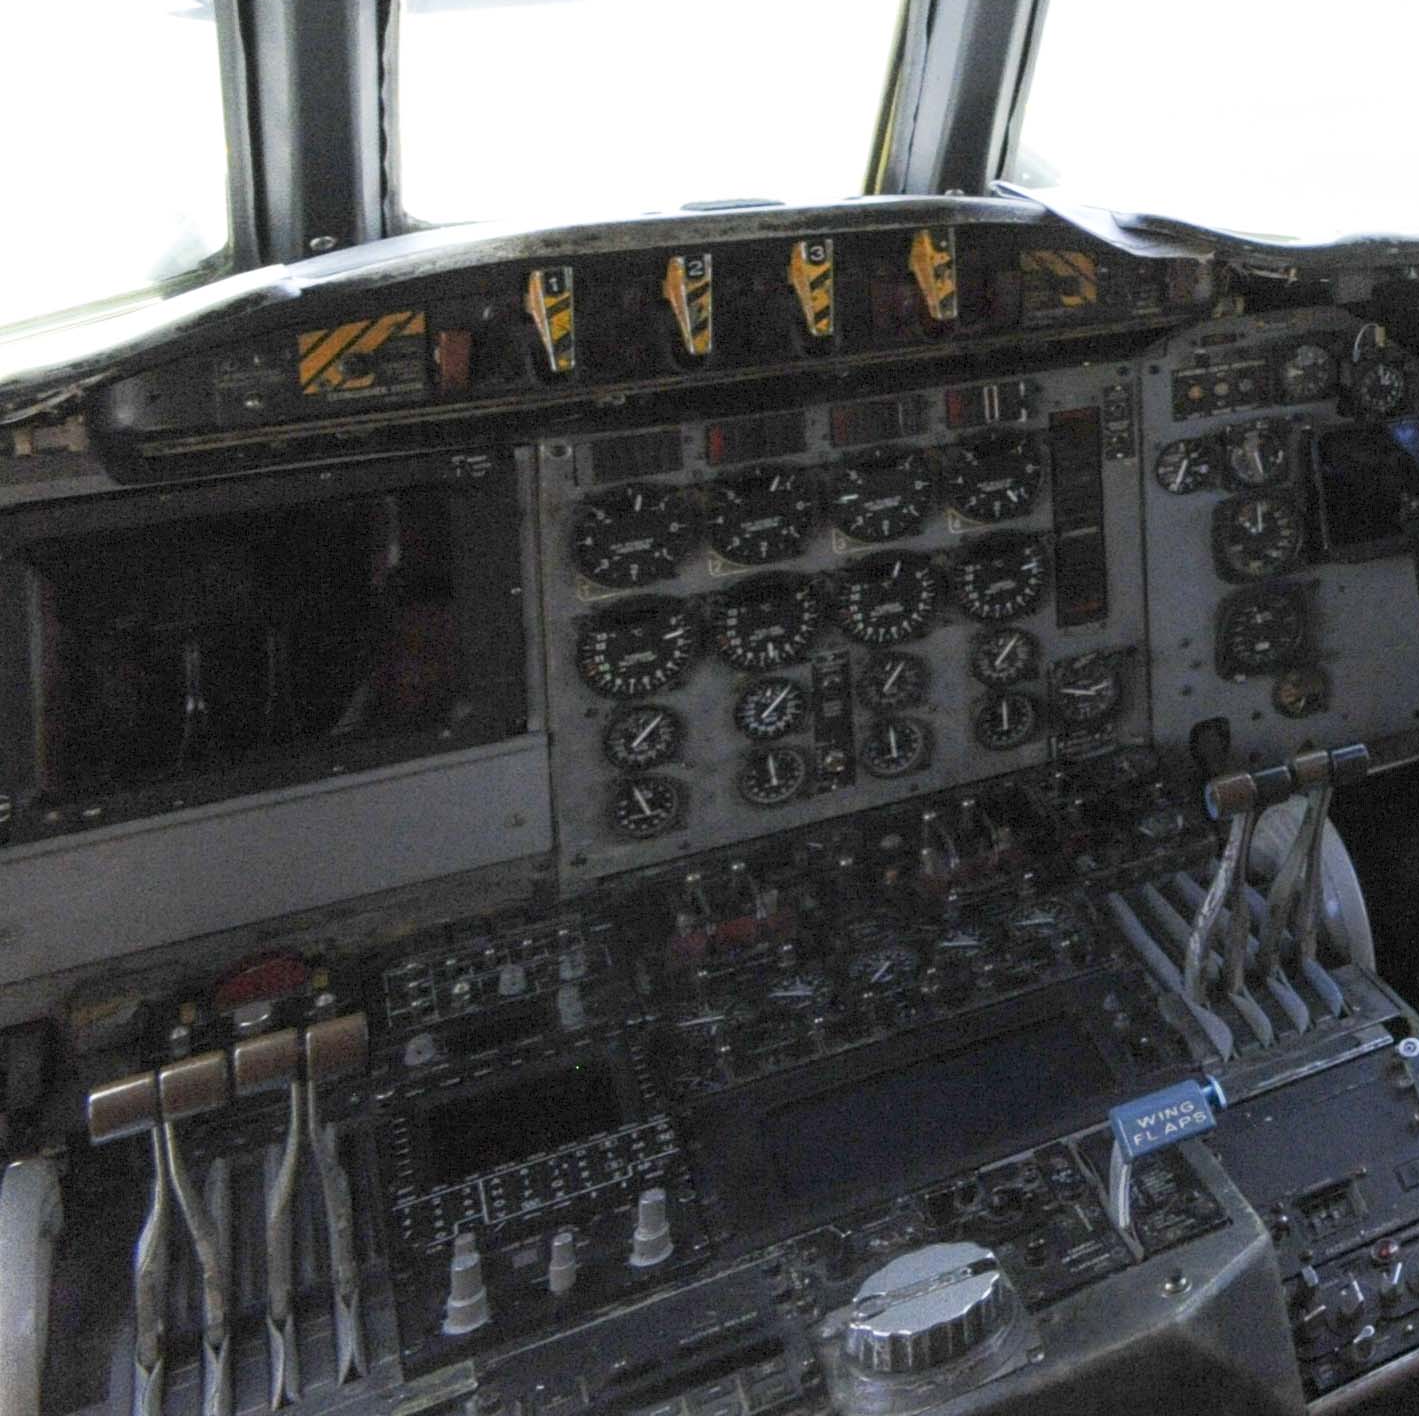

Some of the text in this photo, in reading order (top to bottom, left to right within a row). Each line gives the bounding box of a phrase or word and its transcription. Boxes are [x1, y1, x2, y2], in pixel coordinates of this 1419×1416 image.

[810, 245, 826, 262] 3
[687, 260, 704, 277] 2
[1137, 1100, 1194, 1128] WING
[1133, 1111, 1207, 1146] FLAPS
